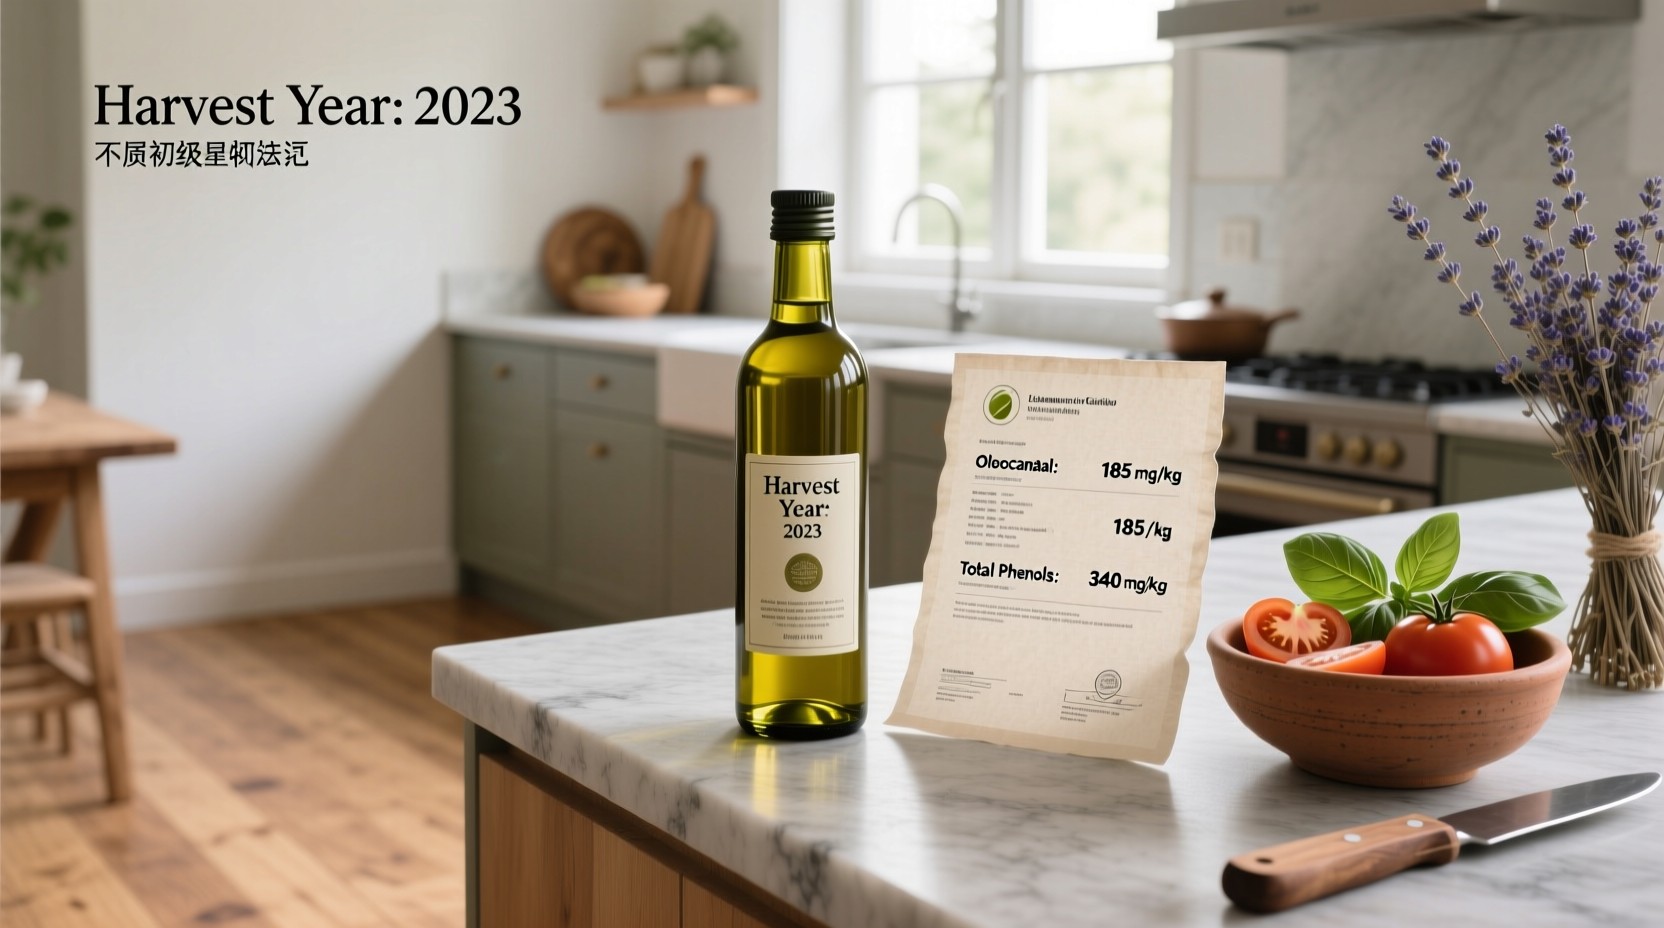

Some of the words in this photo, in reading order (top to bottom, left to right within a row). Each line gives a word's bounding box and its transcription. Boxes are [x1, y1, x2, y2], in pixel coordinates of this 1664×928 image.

[1101, 461, 1132, 479] 185
[1134, 465, 1182, 486] mg/kg
[763, 475, 840, 495] Harvest
[783, 523, 822, 539] 2023
[960, 560, 995, 578] Total
[998, 563, 1060, 584] Phenols:
[1088, 570, 1122, 589] 340
[1124, 575, 1168, 596] mg/kg
